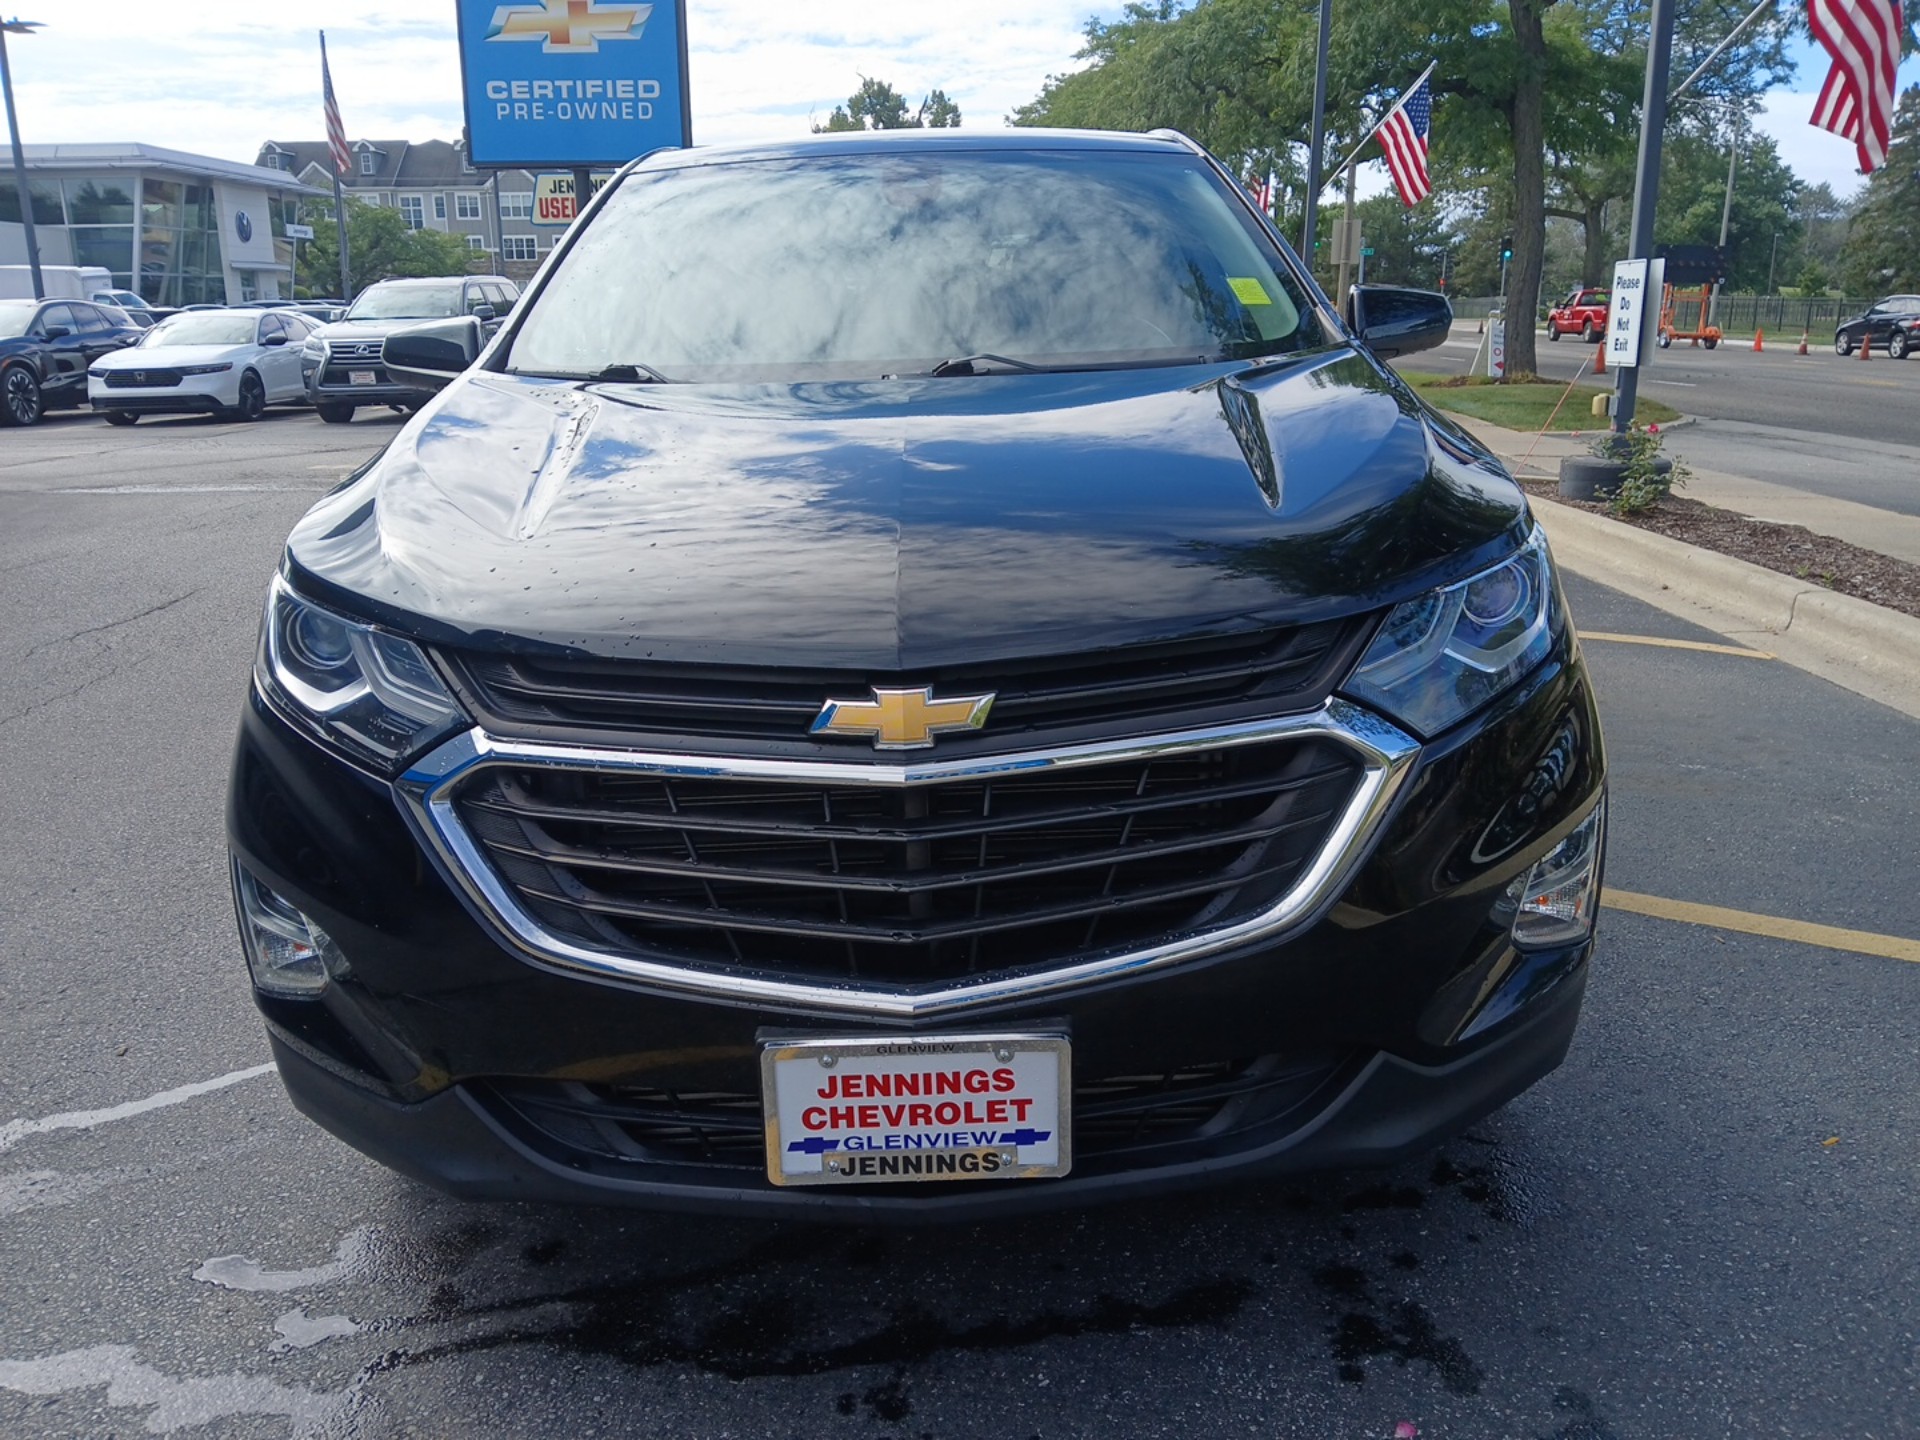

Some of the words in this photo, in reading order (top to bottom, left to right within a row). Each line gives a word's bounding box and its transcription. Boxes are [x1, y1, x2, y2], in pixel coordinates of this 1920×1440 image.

[487, 80, 660, 99] CERTIFIED
[496, 102, 653, 120] PRE-OWNED
[1616, 276, 1640, 289] Please
[1620, 297, 1631, 310] Do
[1617, 318, 1630, 331] Not
[1614, 338, 1628, 351] Exit
[817, 1068, 1016, 1099] JENNINGS
[801, 1098, 1033, 1131] CHEVROLET
[842, 1130, 999, 1151] GLENVIEW
[840, 1152, 1000, 1177] JENNINGS
